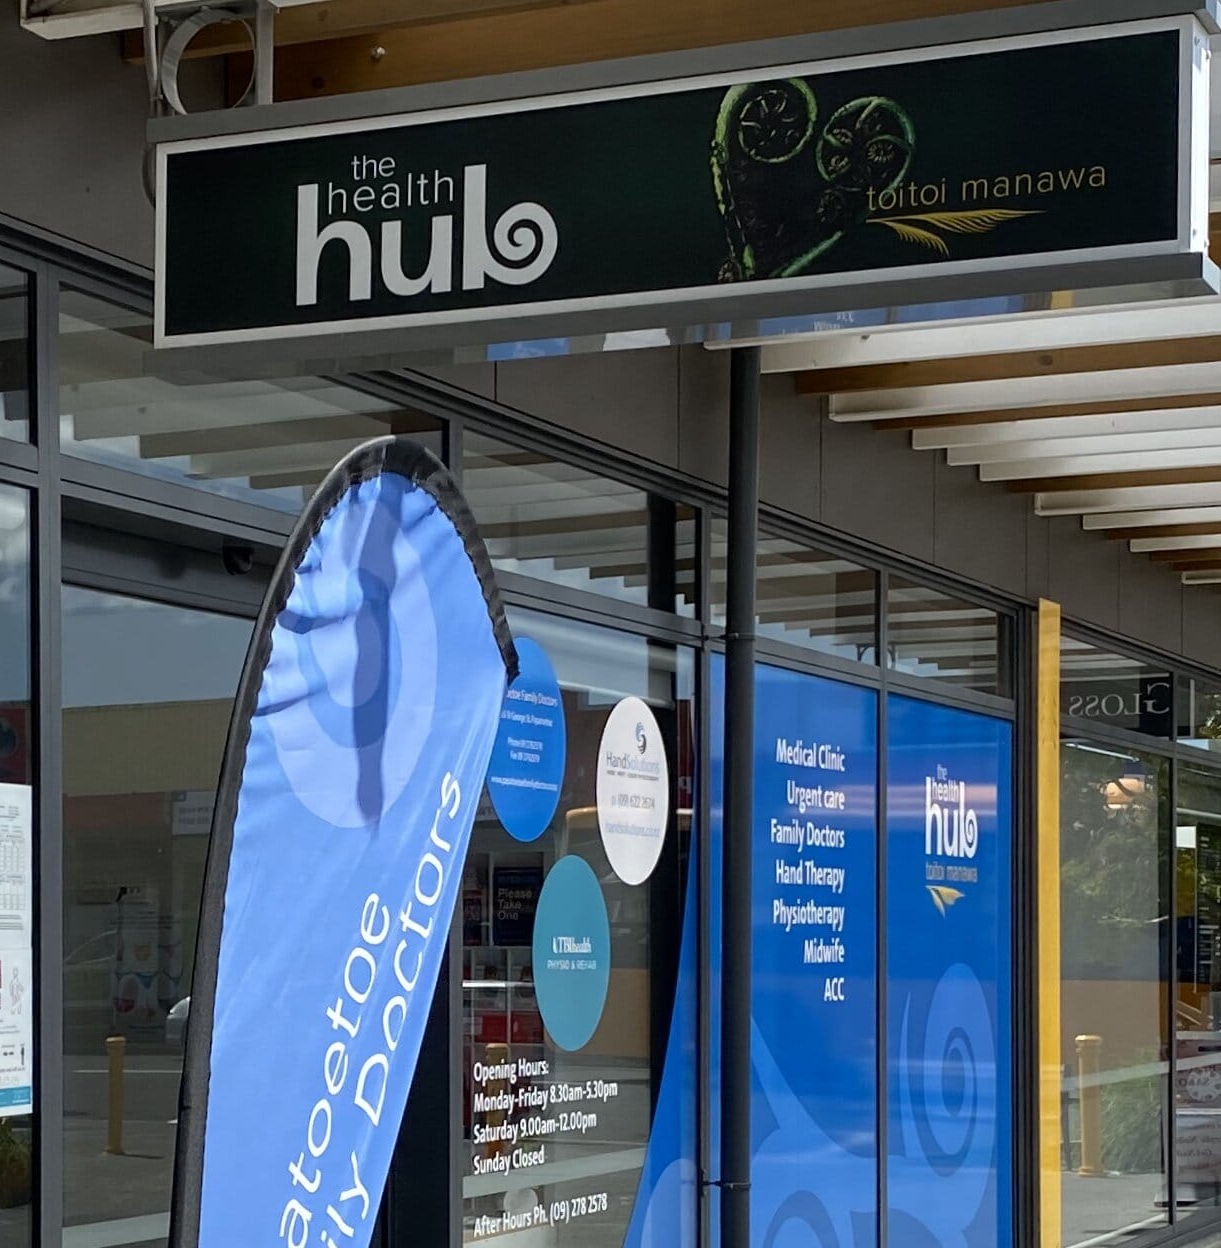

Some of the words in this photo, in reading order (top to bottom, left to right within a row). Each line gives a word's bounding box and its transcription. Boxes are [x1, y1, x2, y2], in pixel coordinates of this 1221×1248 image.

[351, 154, 396, 181] the
[328, 169, 454, 216] health
[866, 177, 947, 212] toitoi
[962, 165, 1106, 201] manawa
[296, 163, 559, 307] hub
[776, 738, 816, 768] Medical
[818, 744, 845, 772] Clinic
[787, 780, 822, 814] Urgent
[824, 790, 845, 810] care
[931, 777, 960, 802] health
[925, 776, 978, 859] hub
[771, 818, 805, 853] Family
[806, 821, 845, 848] Doctors
[776, 859, 803, 885] Hand
[804, 860, 845, 894] Therapy
[773, 898, 845, 932] Physiotherapy
[354, 771, 462, 1127] Doctors
[804, 938, 845, 963] Midwife
[824, 977, 845, 1001] ACC
[473, 1058, 517, 1087] Opening
[518, 1057, 549, 1078] Hours:
[473, 1084, 549, 1115] Monday-Friday
[549, 1080, 618, 1103] 8.30am-5.30pm
[473, 1118, 519, 1145] Saturday
[520, 1111, 597, 1138] 9.00am-12.00pm
[473, 1151, 511, 1176] Sunday
[512, 1145, 545, 1169] Closed
[474, 1214, 500, 1238] After
[502, 1209, 532, 1232] Hours
[533, 1205, 548, 1226] Ph.
[549, 1200, 570, 1227] (09)
[571, 1197, 586, 1217] 278
[587, 1192, 608, 1214] 2578
